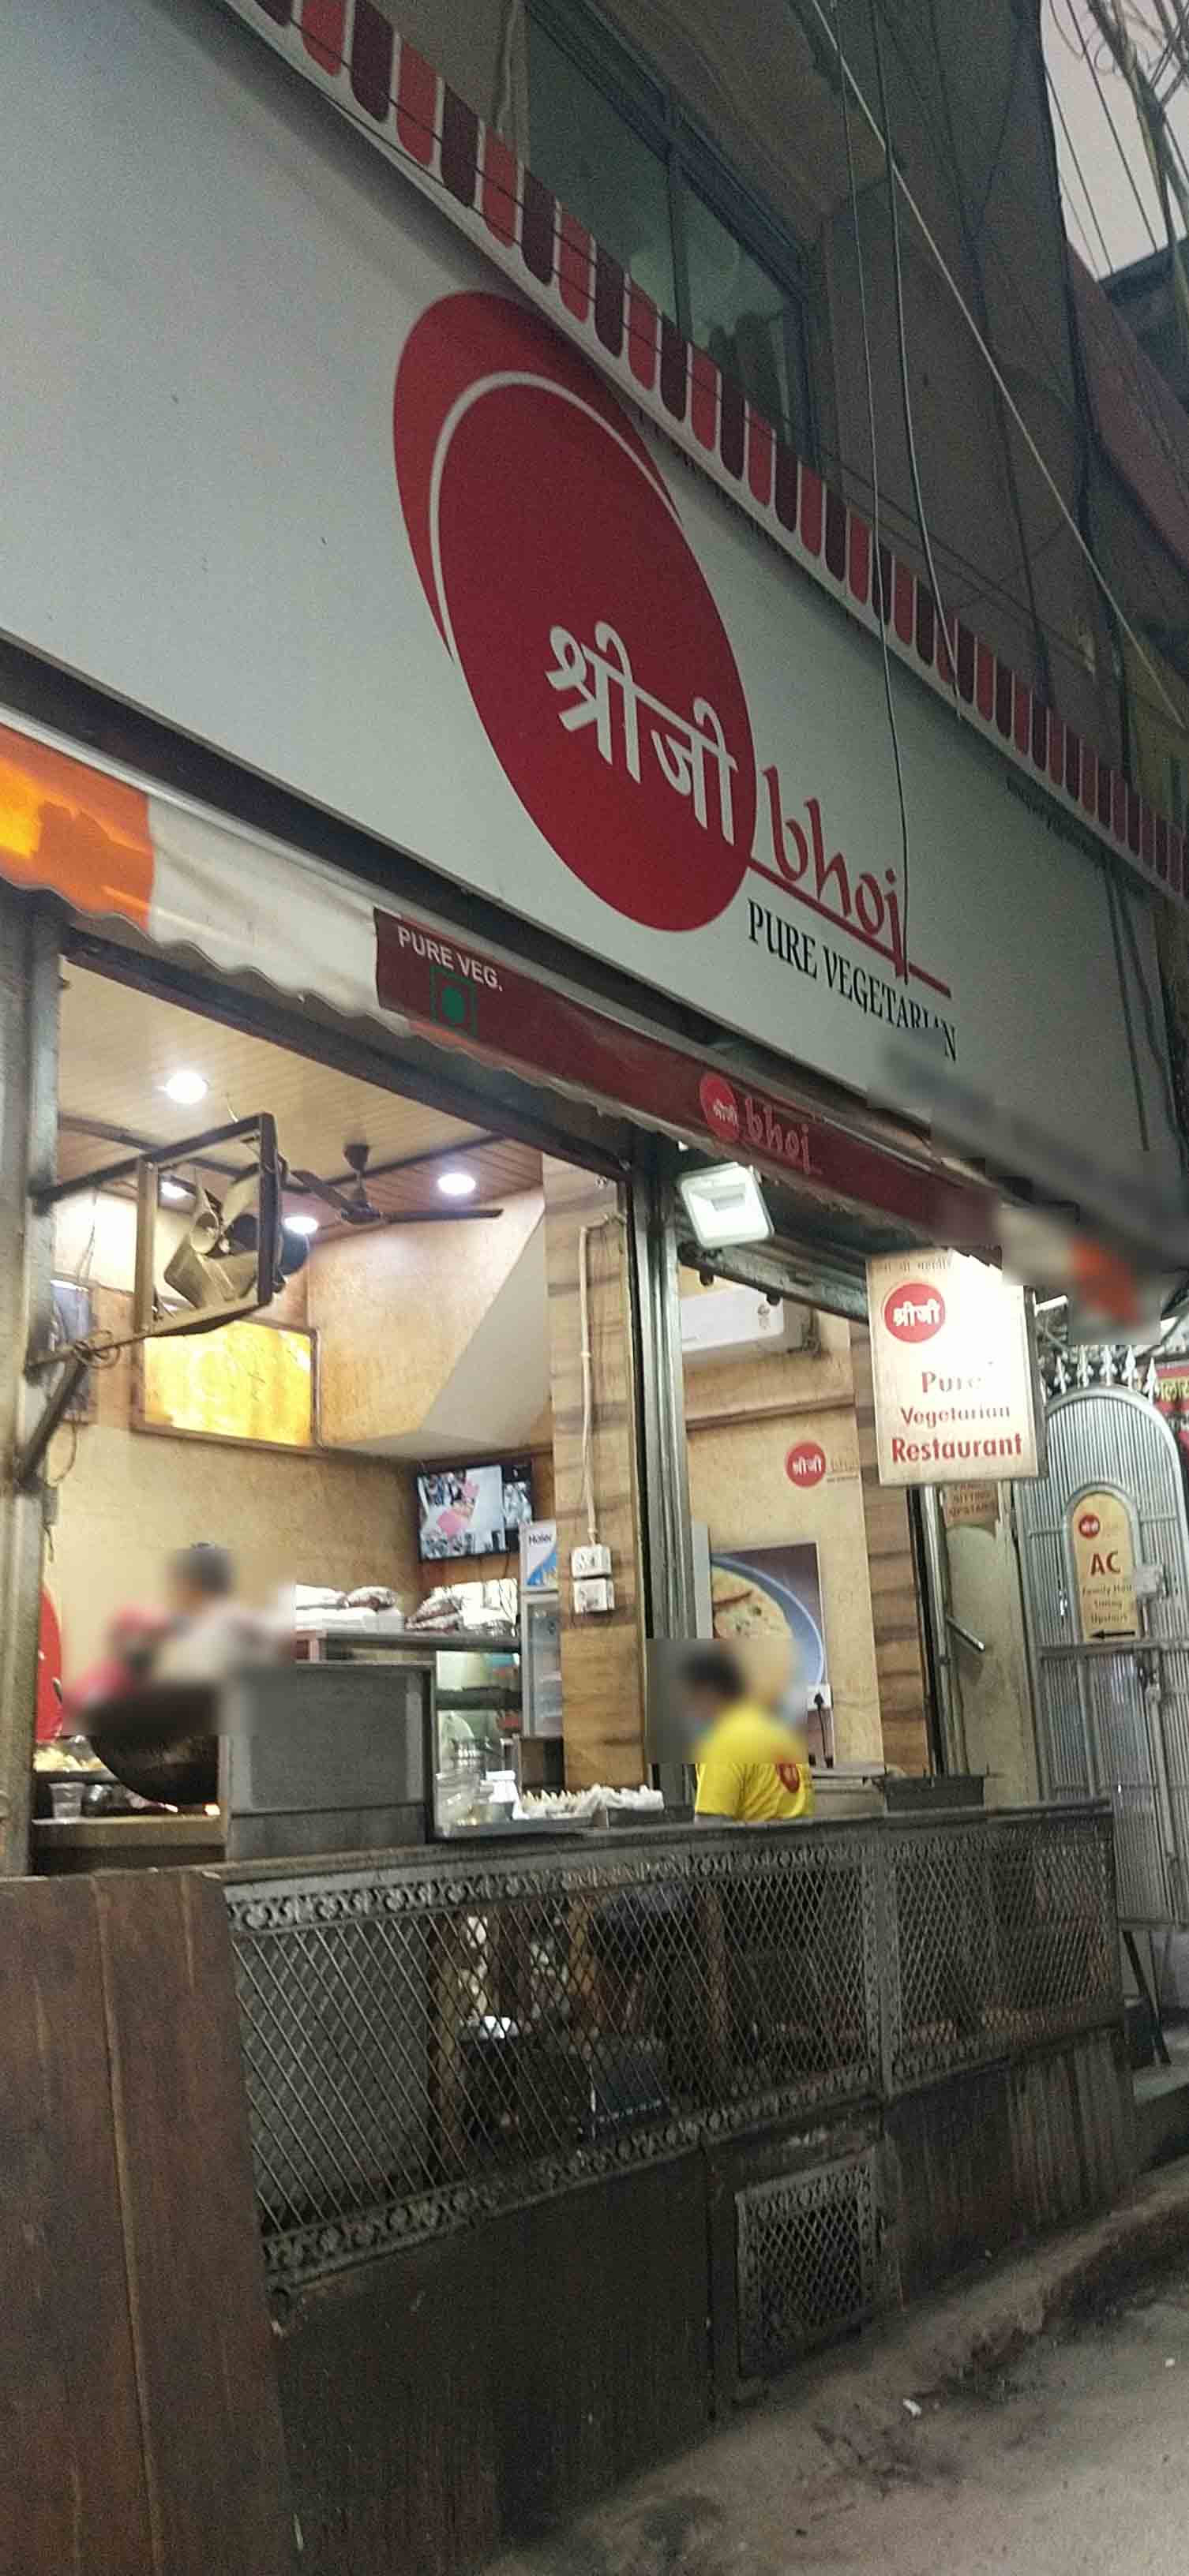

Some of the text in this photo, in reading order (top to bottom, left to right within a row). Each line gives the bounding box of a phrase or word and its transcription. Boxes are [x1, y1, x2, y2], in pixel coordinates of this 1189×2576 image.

[545, 621, 738, 846] श्रीजी
[761, 764, 905, 978] bhoj
[397, 925, 503, 992] PURE VEG.
[748, 897, 817, 980] PURE
[745, 1098, 811, 1174] bhoj
[893, 1298, 940, 1327] श्रीजी
[891, 1432, 1022, 1465] Restaurant
[900, 1406, 1010, 1429] Vegetarian
[1090, 1551, 1121, 1575] AC
